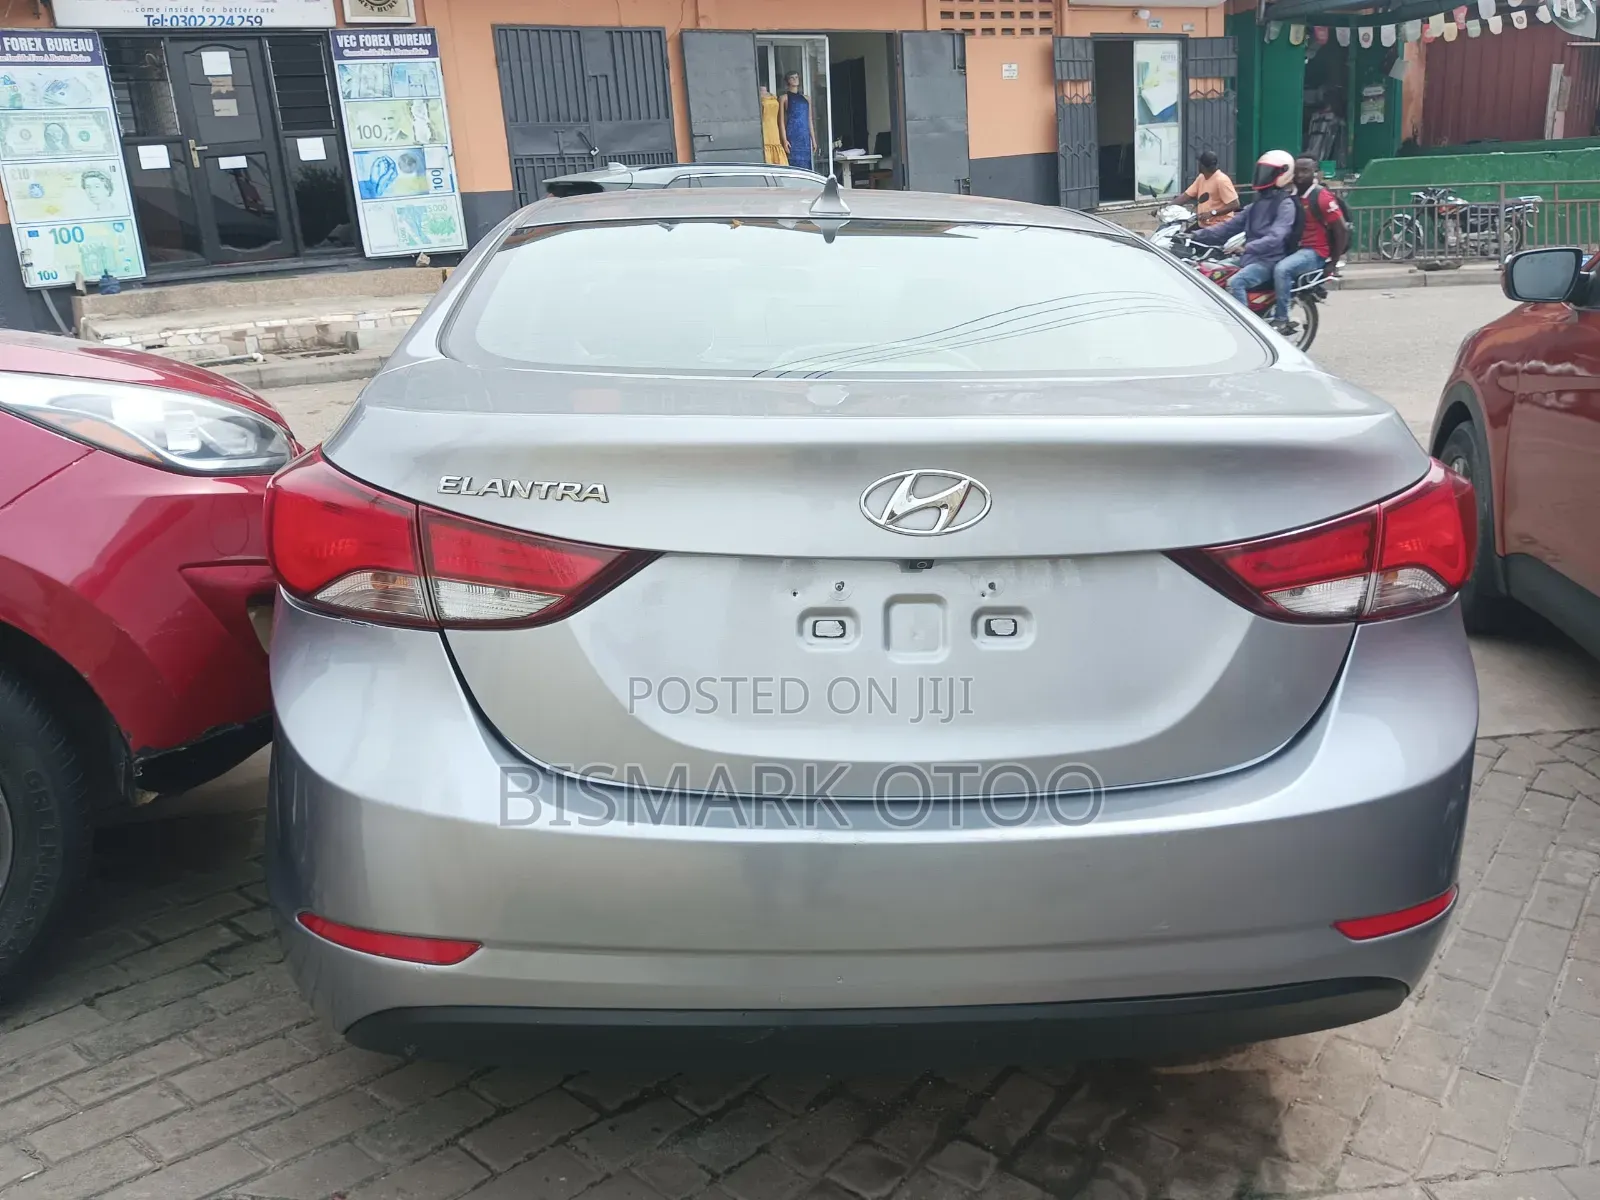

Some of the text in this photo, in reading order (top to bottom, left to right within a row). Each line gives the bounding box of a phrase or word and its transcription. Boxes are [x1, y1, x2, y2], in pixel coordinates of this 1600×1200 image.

[2, 37, 94, 52] FOREX BUREAU
[336, 33, 432, 47] VEC FOREX BUREAU
[357, 125, 382, 140] 100
[431, 169, 444, 190] 100
[49, 226, 85, 245] 100
[37, 270, 59, 281] 100
[437, 475, 609, 503] ELANTRA
